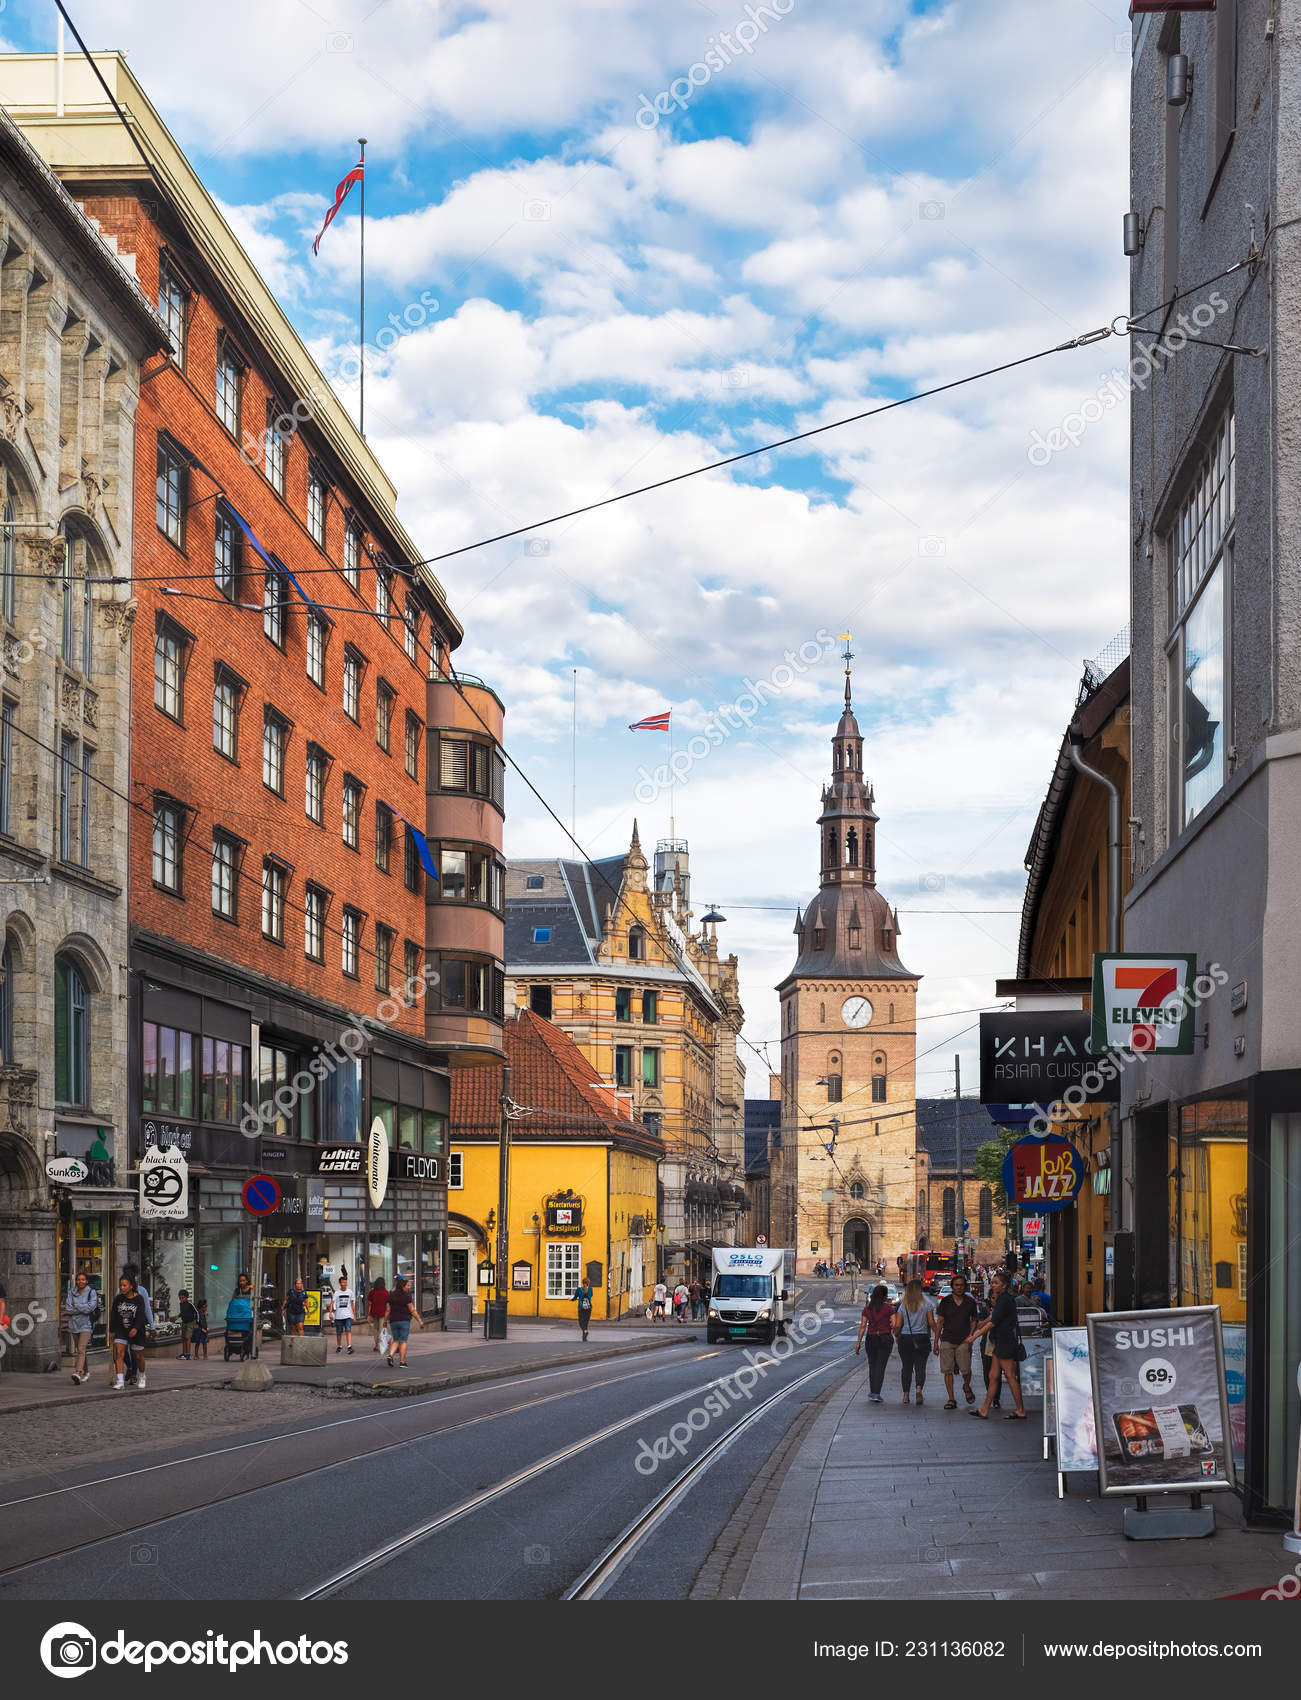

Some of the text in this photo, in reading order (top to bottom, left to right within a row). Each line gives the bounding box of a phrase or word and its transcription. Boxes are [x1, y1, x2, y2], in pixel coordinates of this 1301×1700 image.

[995, 1063, 1040, 1079] ASIAN
[145, 1156, 167, 1164] black
[407, 1156, 438, 1179] FLOYD
[48, 1167, 85, 1178] Sunkost
[1023, 1174, 1073, 1199] JAZZ
[1115, 1327, 1194, 1350] SUSHI
